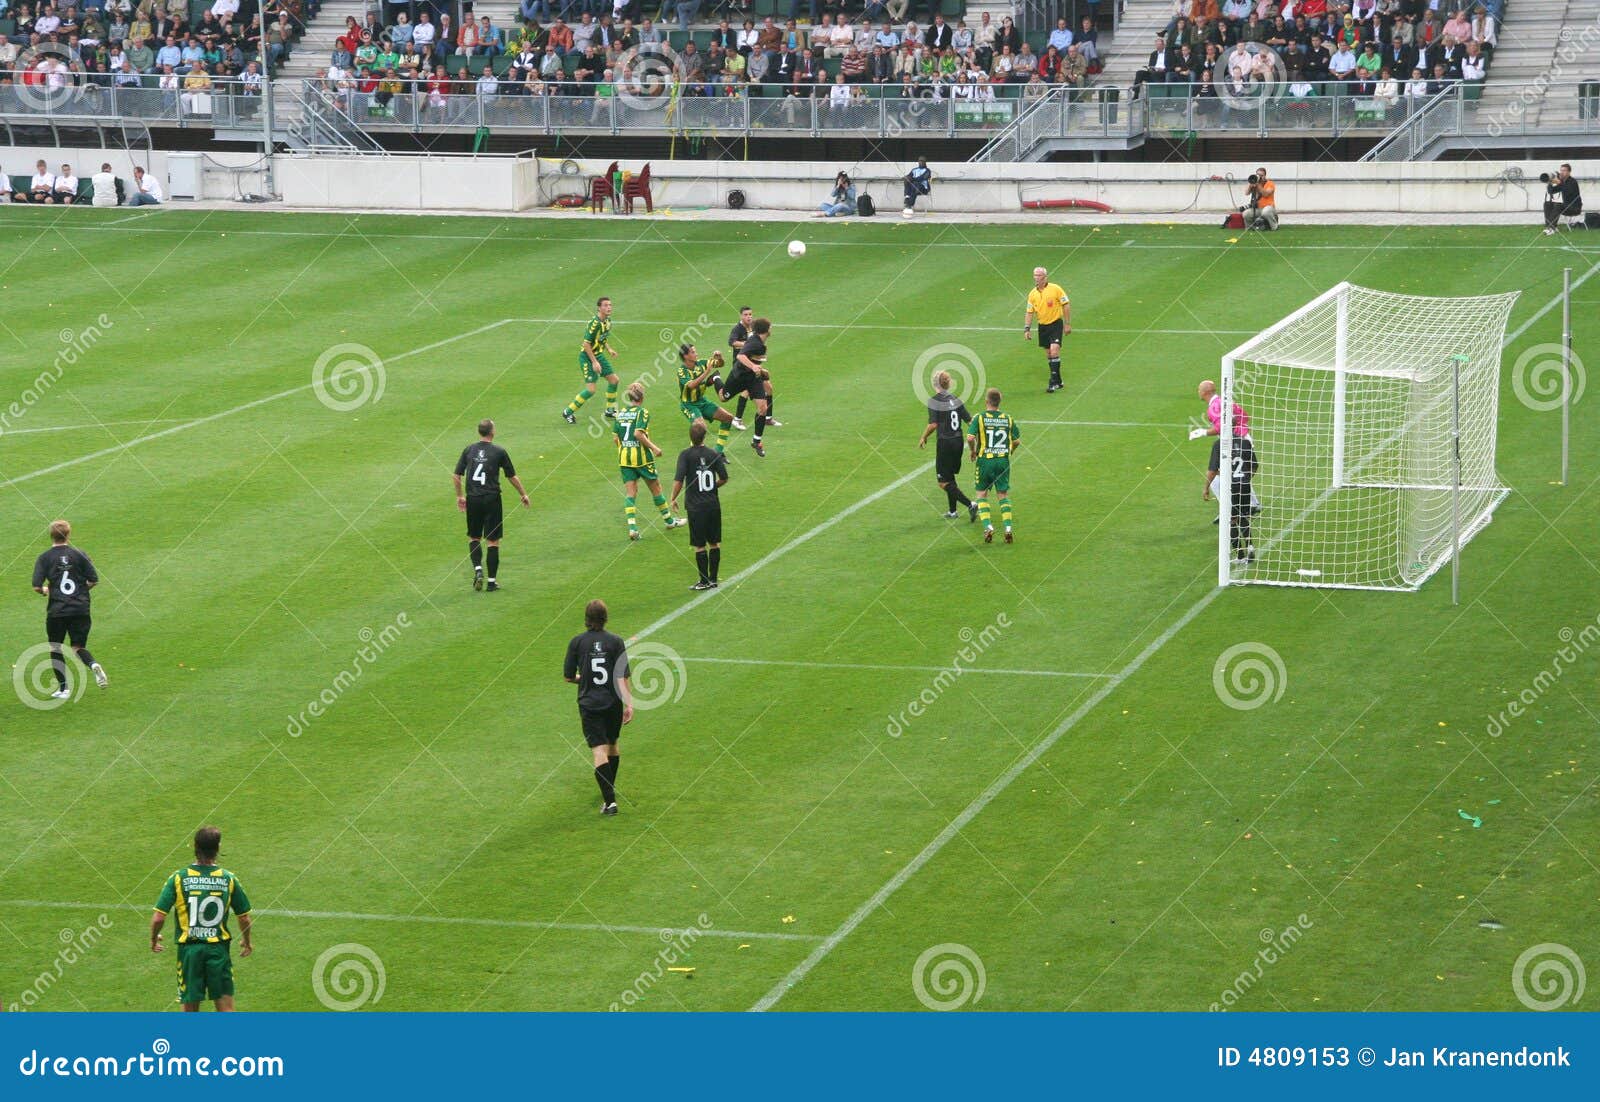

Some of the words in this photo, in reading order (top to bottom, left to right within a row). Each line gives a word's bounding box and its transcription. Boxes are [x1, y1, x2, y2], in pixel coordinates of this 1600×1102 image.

[620, 422, 631, 441] 7
[950, 410, 960, 431] 8
[986, 429, 1008, 448] 12
[472, 463, 486, 486] 4
[1232, 456, 1245, 478] 2
[696, 470, 715, 492] 10
[60, 570, 76, 595] 6
[591, 657, 609, 685] 5
[188, 896, 224, 927] 10
